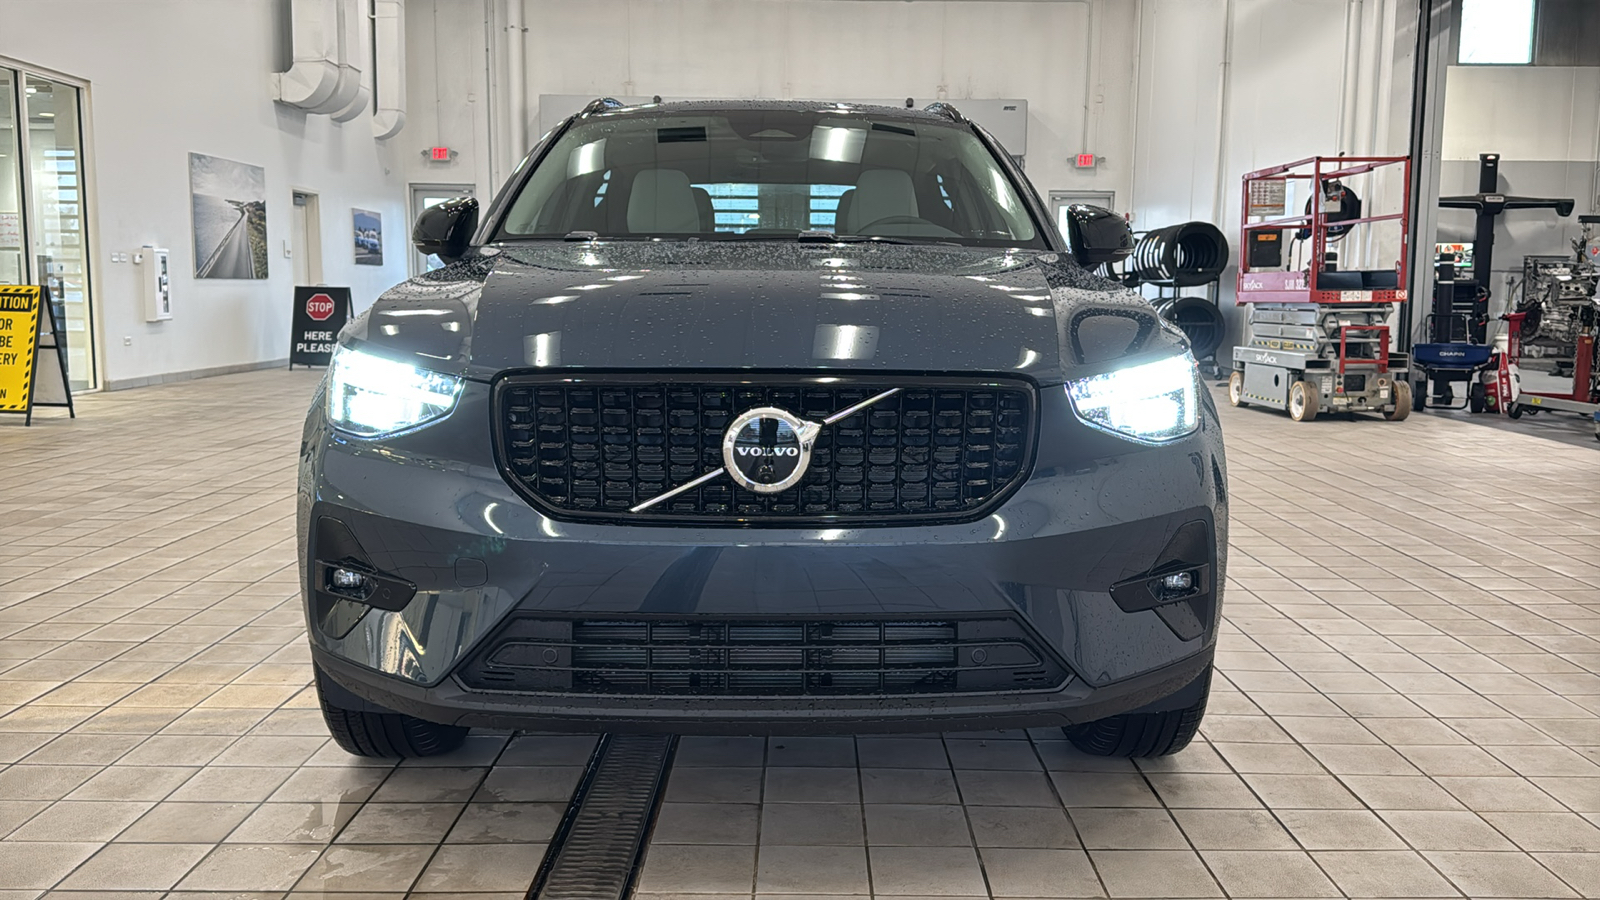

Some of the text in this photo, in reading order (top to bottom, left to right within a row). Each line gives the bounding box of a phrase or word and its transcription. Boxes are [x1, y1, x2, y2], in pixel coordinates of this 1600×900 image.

[308, 302, 333, 312] STOP
[304, 331, 333, 340] HERE
[0, 336, 13, 348] BE
[736, 446, 799, 457] VOLVO
